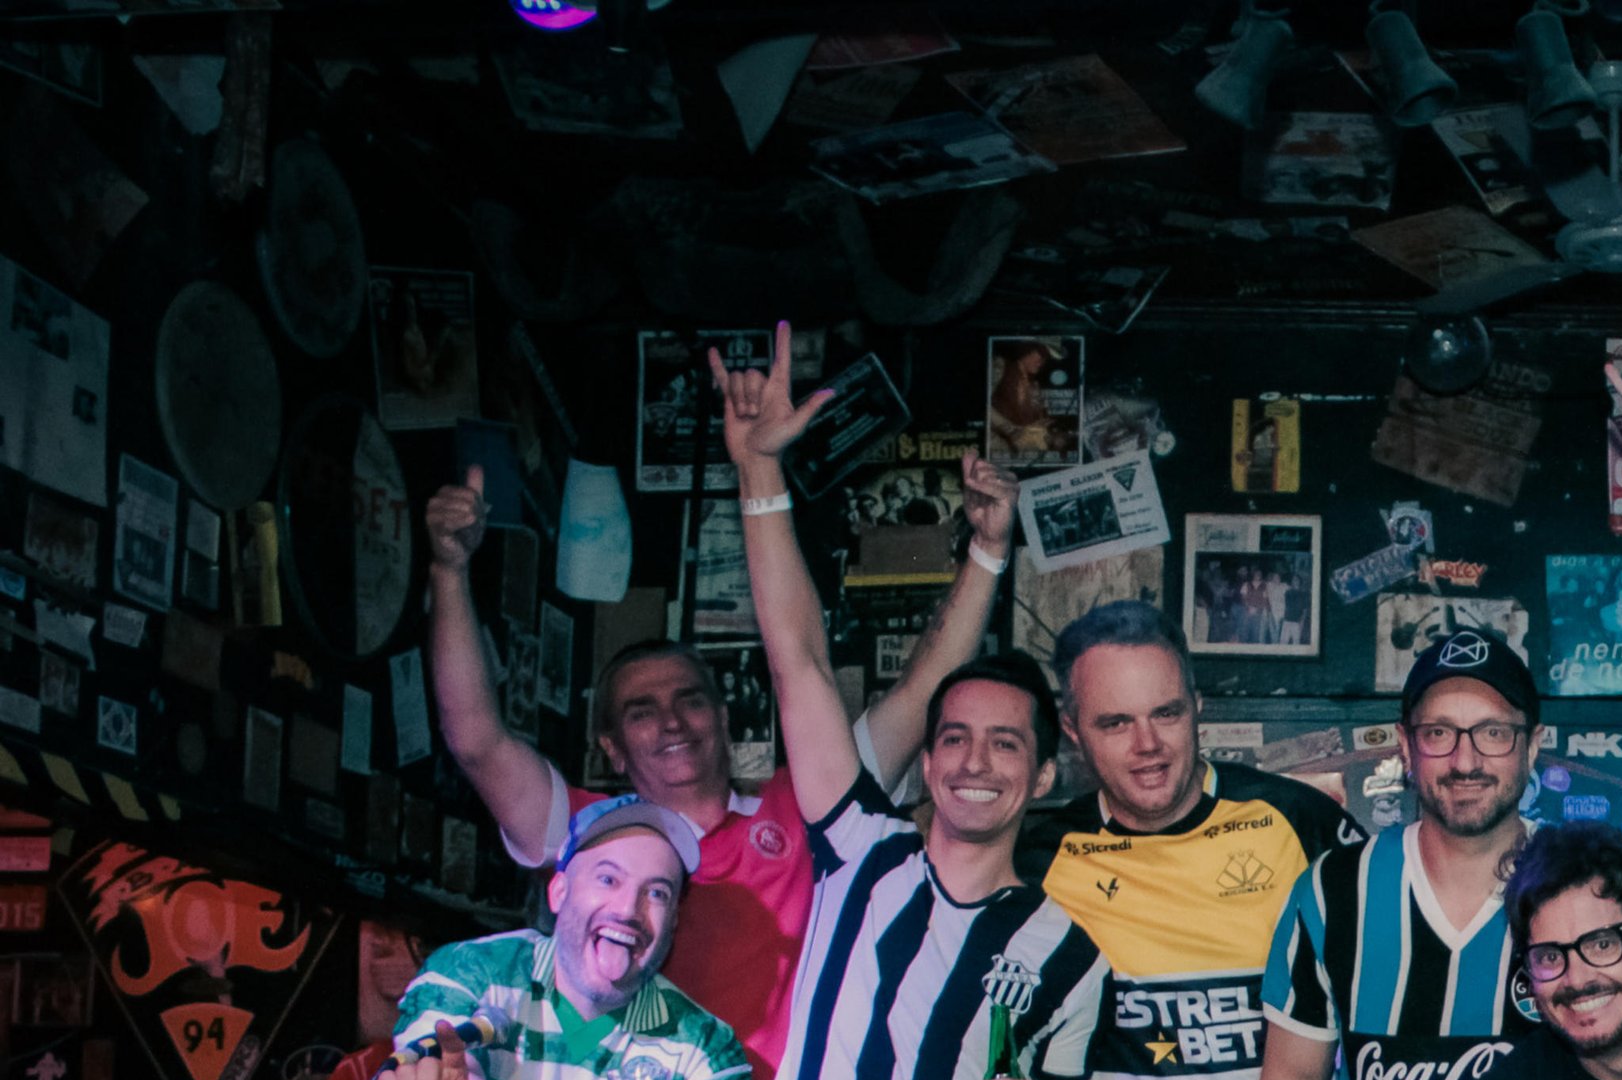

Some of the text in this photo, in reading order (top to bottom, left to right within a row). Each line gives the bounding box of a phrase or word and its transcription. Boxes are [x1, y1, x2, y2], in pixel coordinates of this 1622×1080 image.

[1550, 659, 1585, 682] de
[1222, 814, 1273, 834] Sicredi
[1082, 838, 1132, 856] Sicredi
[1115, 986, 1263, 1029] ESTREL
[183, 1017, 226, 1053] 94
[1178, 1021, 1262, 1065] BET
